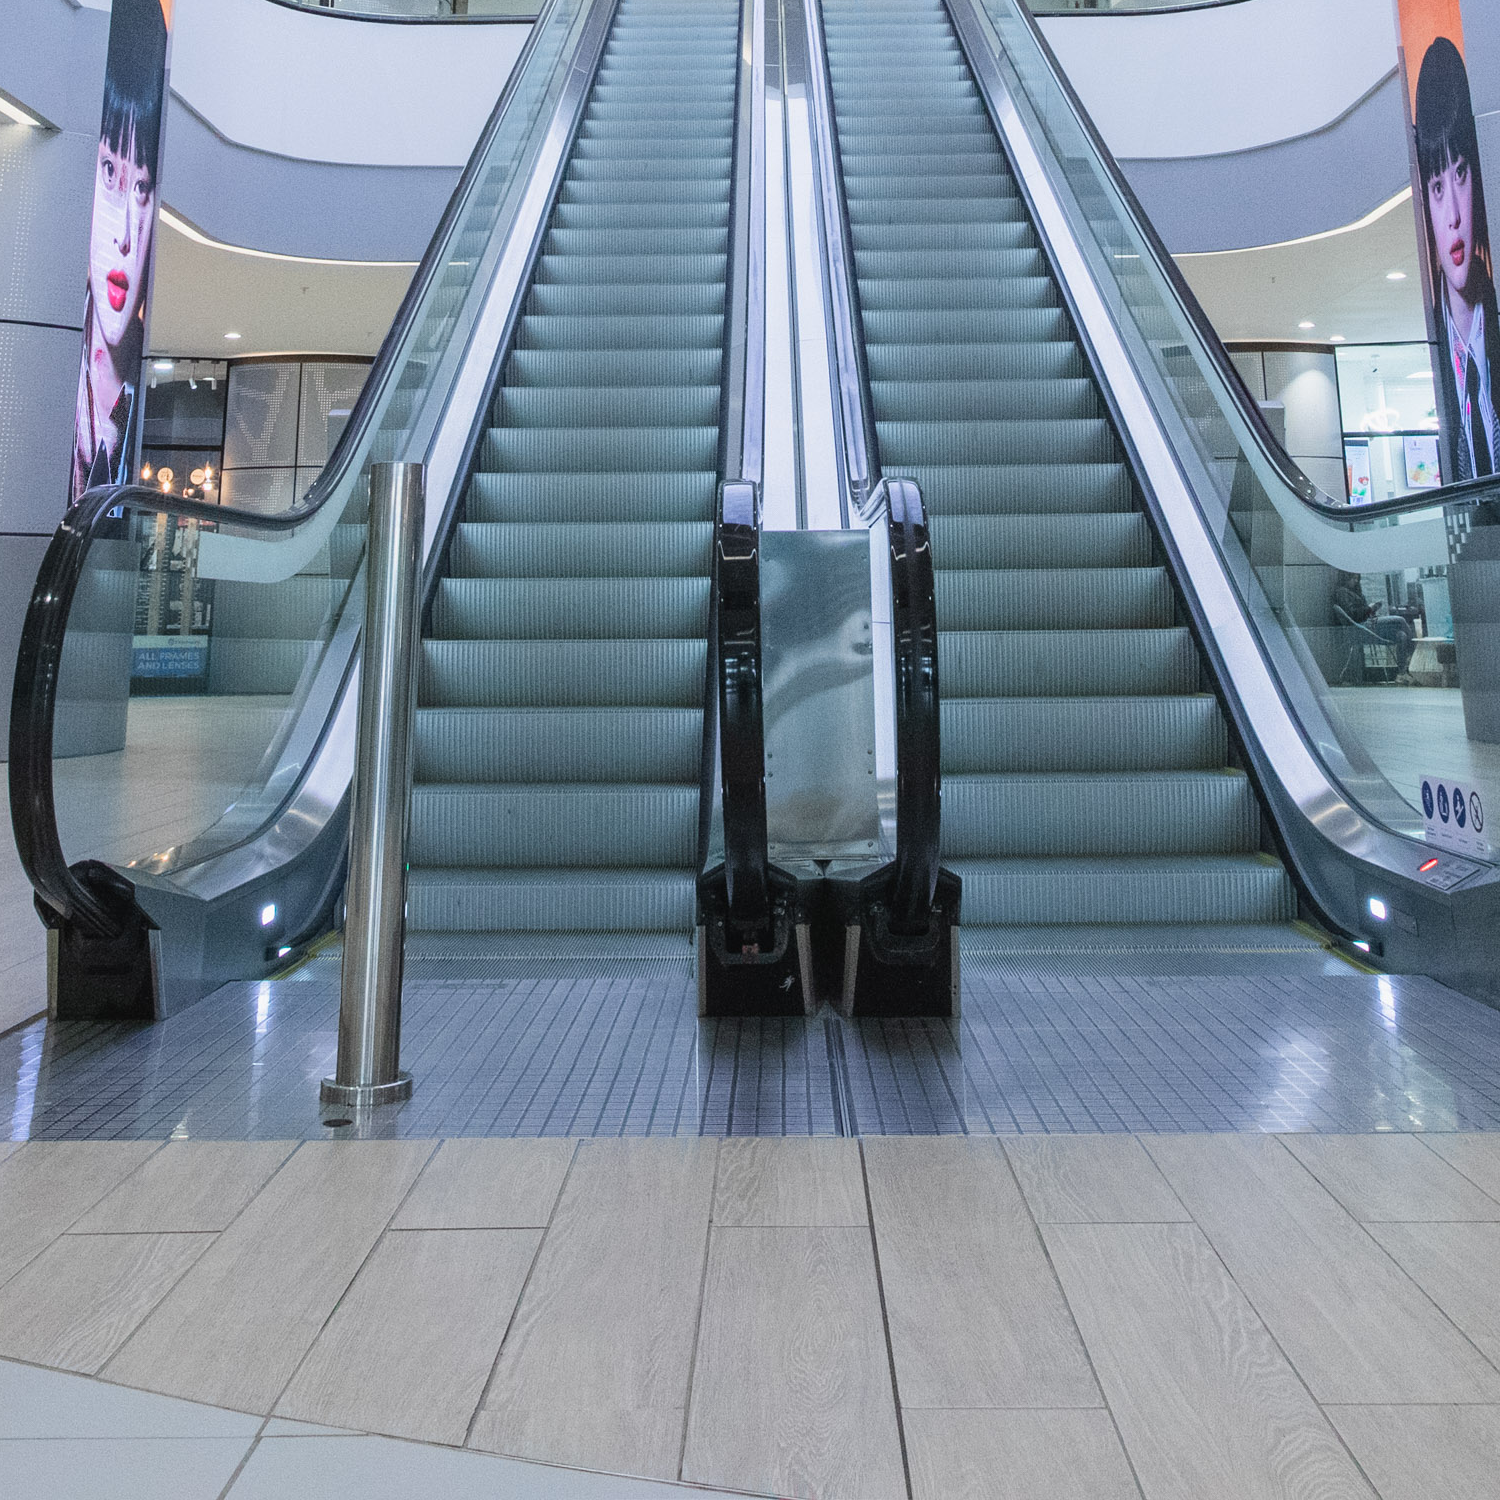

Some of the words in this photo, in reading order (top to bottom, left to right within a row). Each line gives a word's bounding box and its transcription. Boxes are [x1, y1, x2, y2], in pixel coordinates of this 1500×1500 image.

[138, 652, 156, 661] ALL
[159, 651, 200, 661] FRAMES
[137, 662, 160, 670] AND
[161, 661, 200, 670] LENSES
